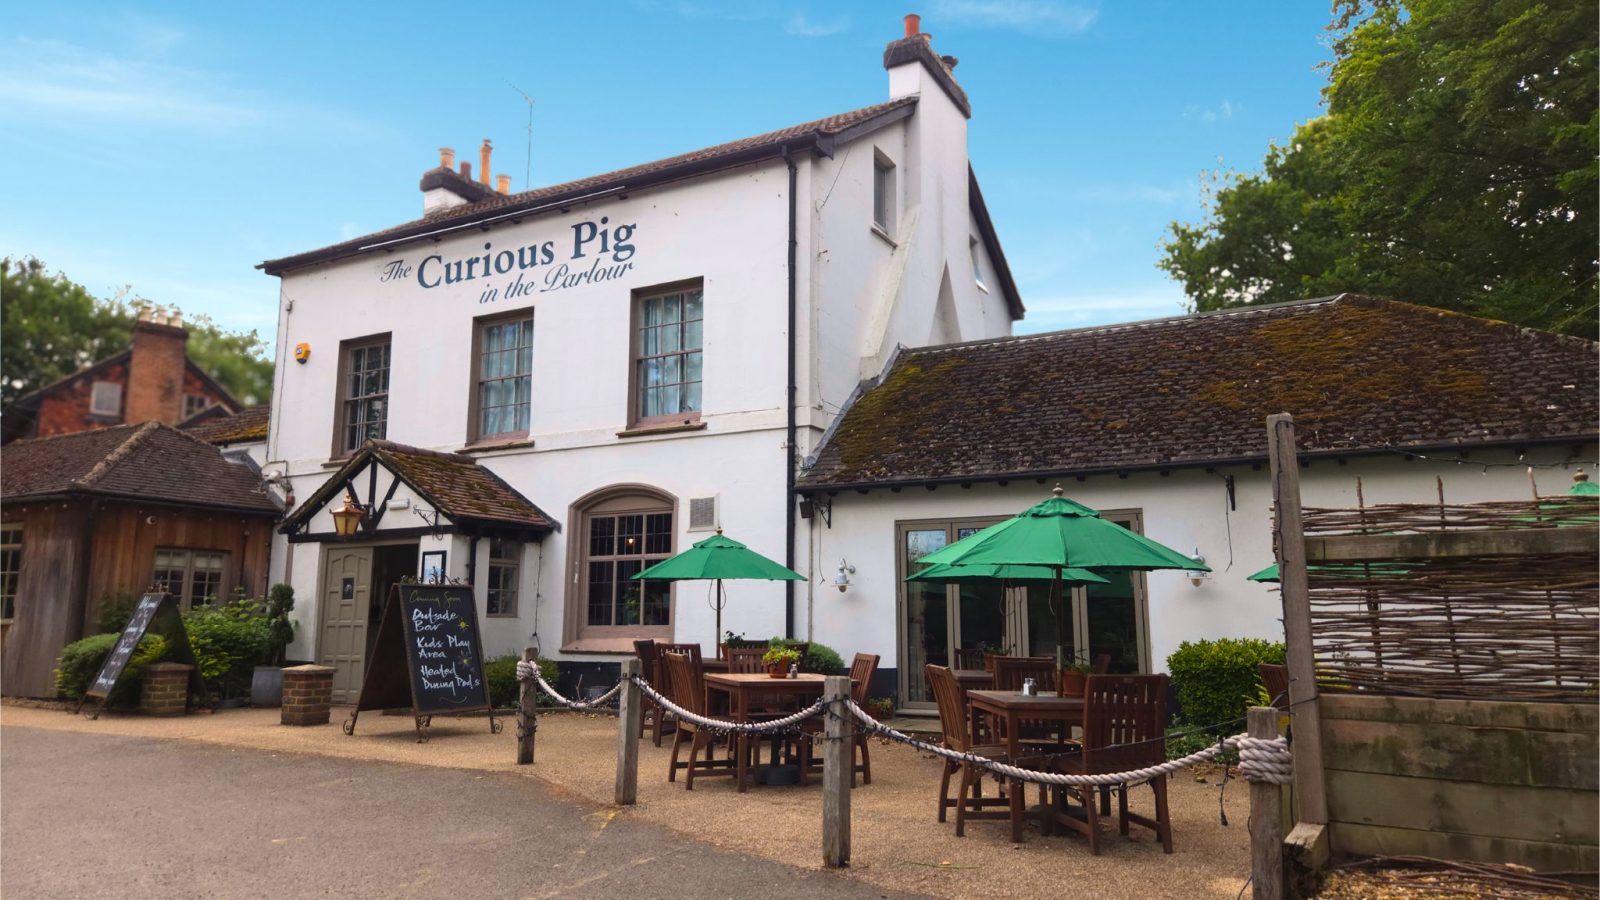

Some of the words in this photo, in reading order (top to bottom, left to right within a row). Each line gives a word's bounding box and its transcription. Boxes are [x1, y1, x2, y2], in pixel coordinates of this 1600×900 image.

[380, 259, 412, 282] The
[417, 242, 554, 289] Curious
[570, 216, 637, 262] Pig
[479, 283, 498, 304] in
[504, 273, 535, 299] the
[540, 257, 634, 292] Parlour
[415, 620, 442, 632] Bar
[417, 636, 445, 649] Kids
[446, 634, 470, 654] Play
[419, 648, 446, 658] Area
[421, 662, 457, 677] Heated
[422, 677, 456, 696] Dining
